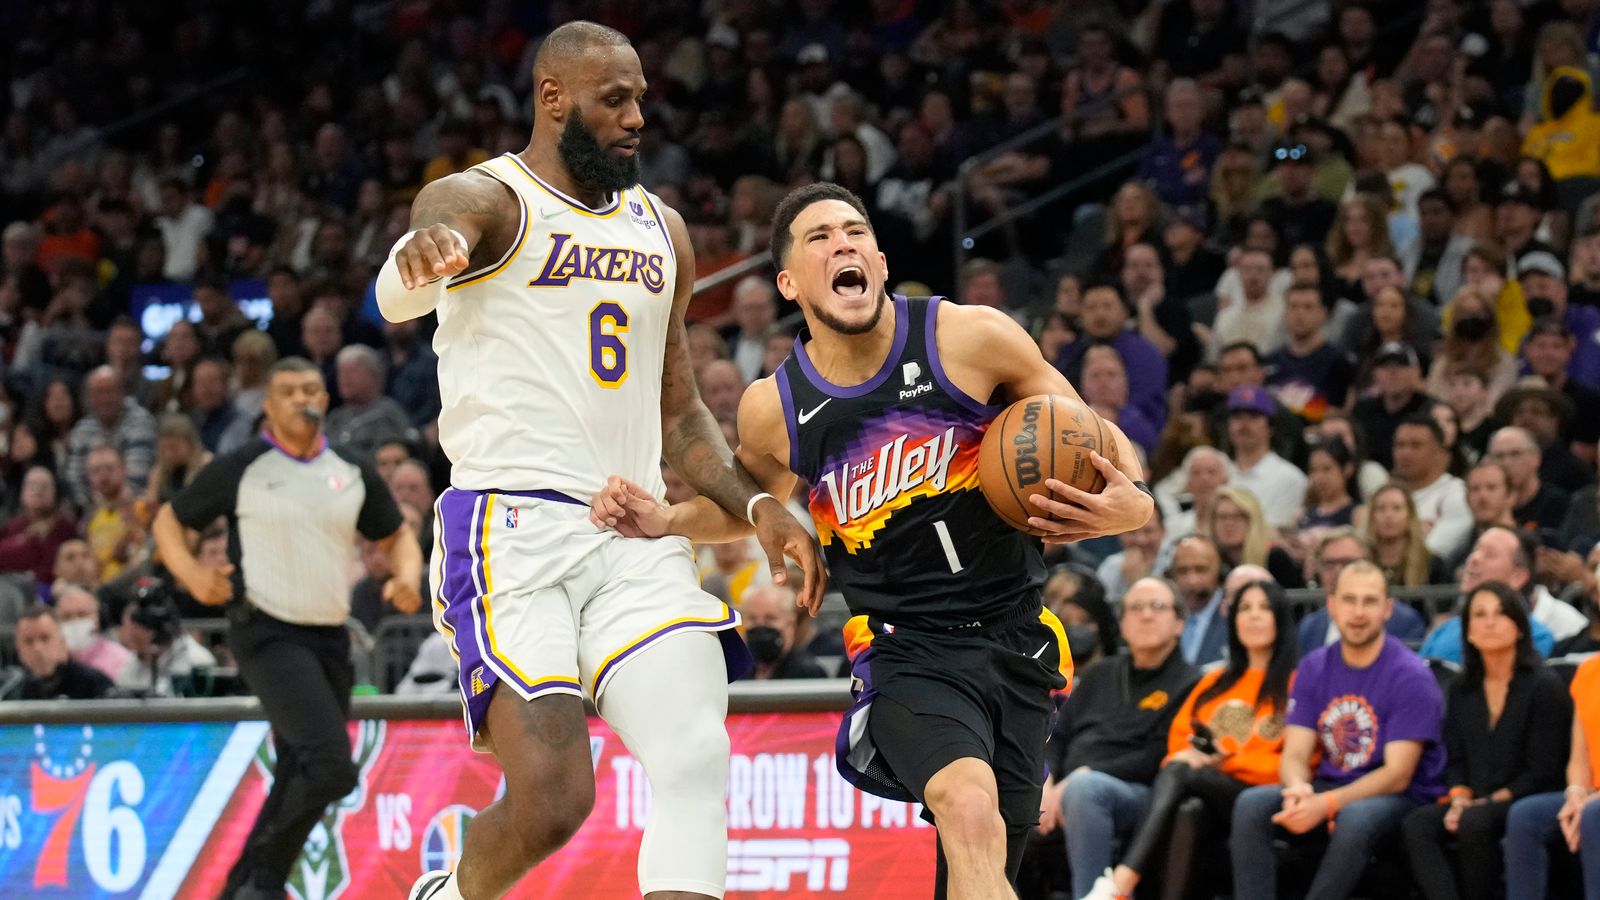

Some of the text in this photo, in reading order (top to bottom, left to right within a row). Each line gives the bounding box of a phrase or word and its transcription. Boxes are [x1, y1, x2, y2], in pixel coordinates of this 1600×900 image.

[526, 232, 665, 294] LAKERS
[587, 299, 630, 389] 6
[899, 381, 933, 400] PayPal
[821, 426, 960, 526] Valley
[851, 456, 875, 479] THE
[1014, 401, 1043, 489] Wilson
[932, 520, 965, 574] 1
[0, 794, 22, 850] S
[375, 792, 413, 852] VS
[611, 752, 809, 830] TOROW
[30, 759, 148, 893] 76
